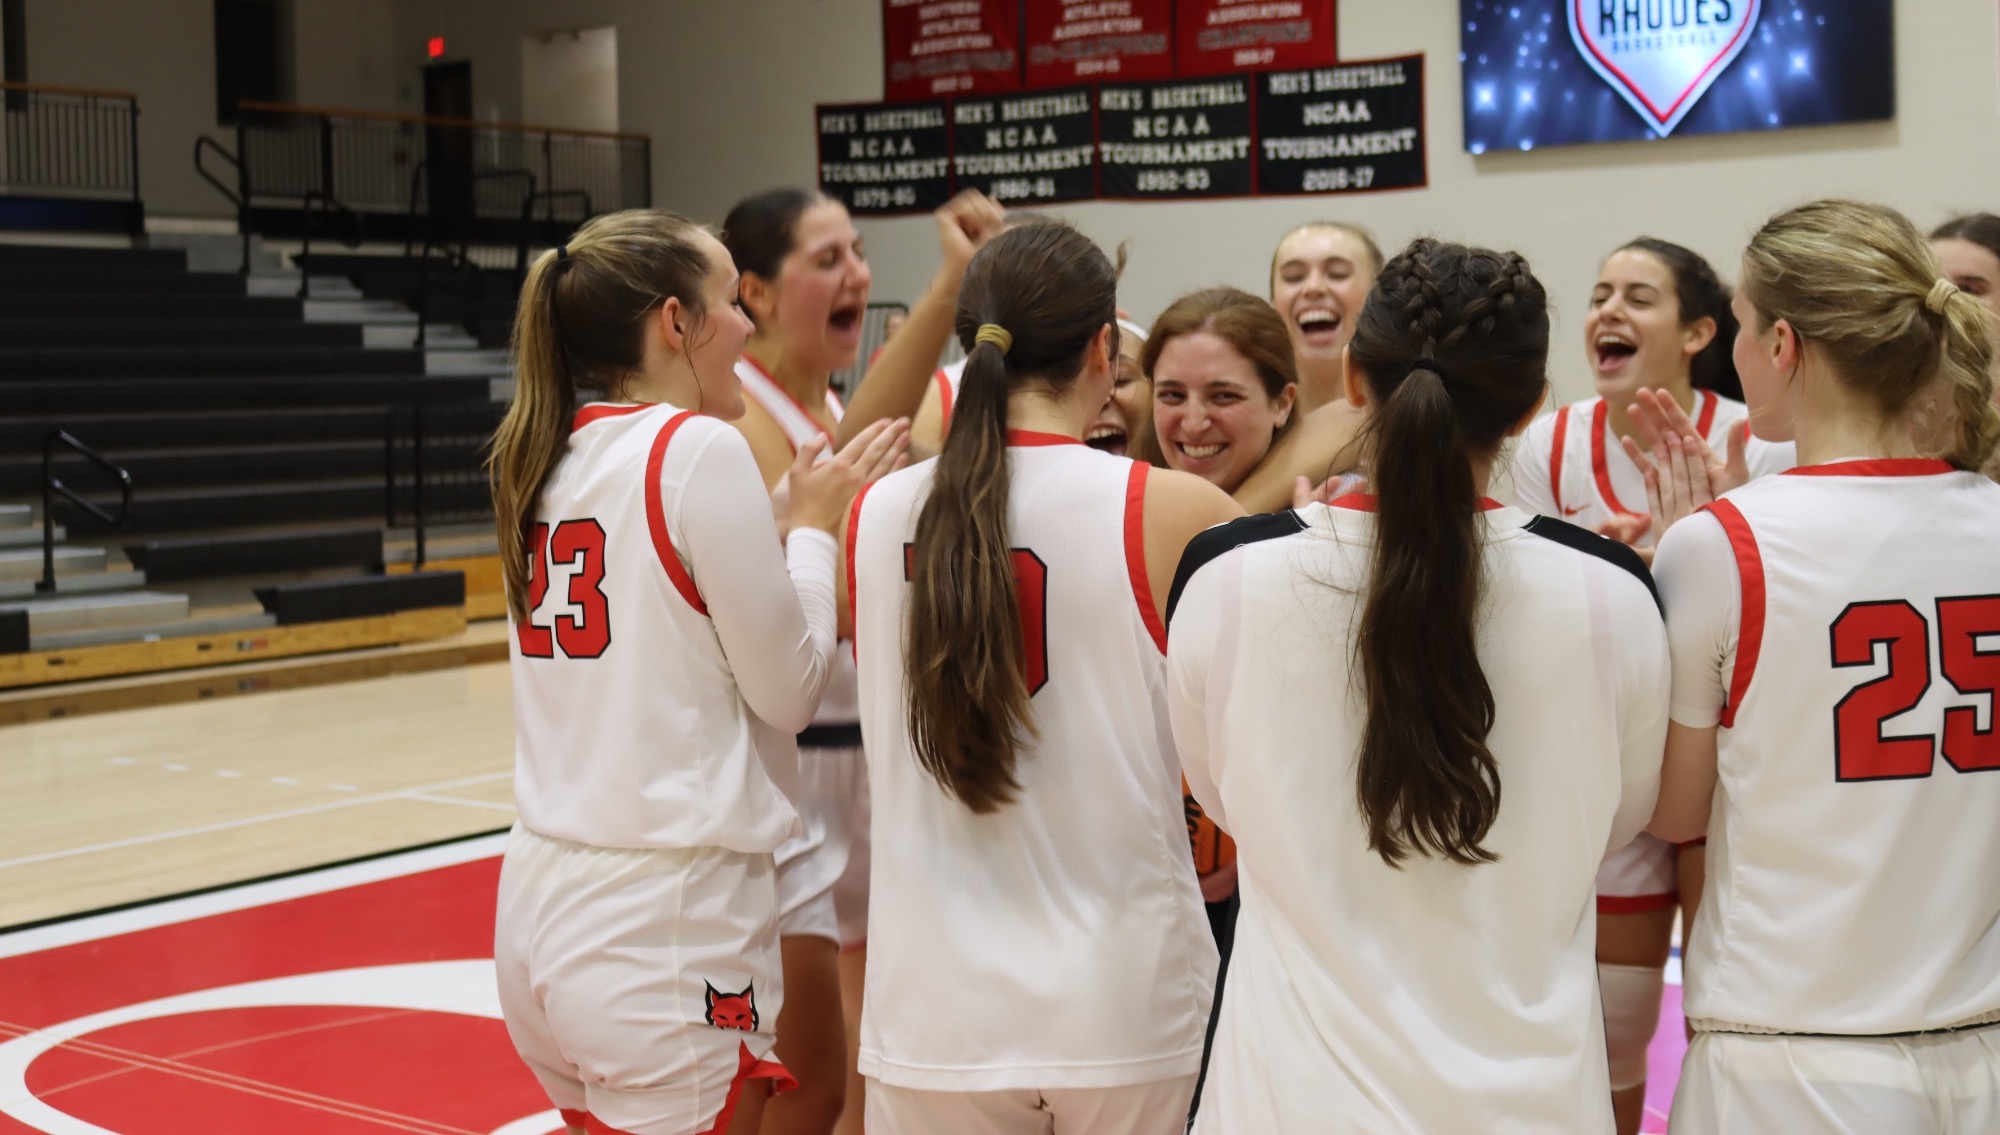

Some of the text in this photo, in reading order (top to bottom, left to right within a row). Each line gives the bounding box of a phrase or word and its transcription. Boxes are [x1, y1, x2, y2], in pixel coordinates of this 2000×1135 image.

[1206, 4, 1302, 25] ASSOCIATION
[1600, 0, 1732, 36] RHODES
[1313, 65, 1406, 90] BASKETBALL
[1002, 94, 1090, 120] BASKETBALL
[1152, 83, 1247, 108] BASKETBALL
[864, 109, 945, 131] BASKETBALL
[1303, 101, 1372, 125] NCAA
[1101, 138, 1251, 163] TOURNAMENT
[1262, 129, 1417, 159] TOURNAMENT
[822, 159, 949, 181] TOURNAMENT
[954, 146, 1093, 174] TOURNAMENT
[1302, 168, 1374, 190] 2016-17
[516, 517, 612, 659] 23
[1829, 593, 2000, 783] 25
